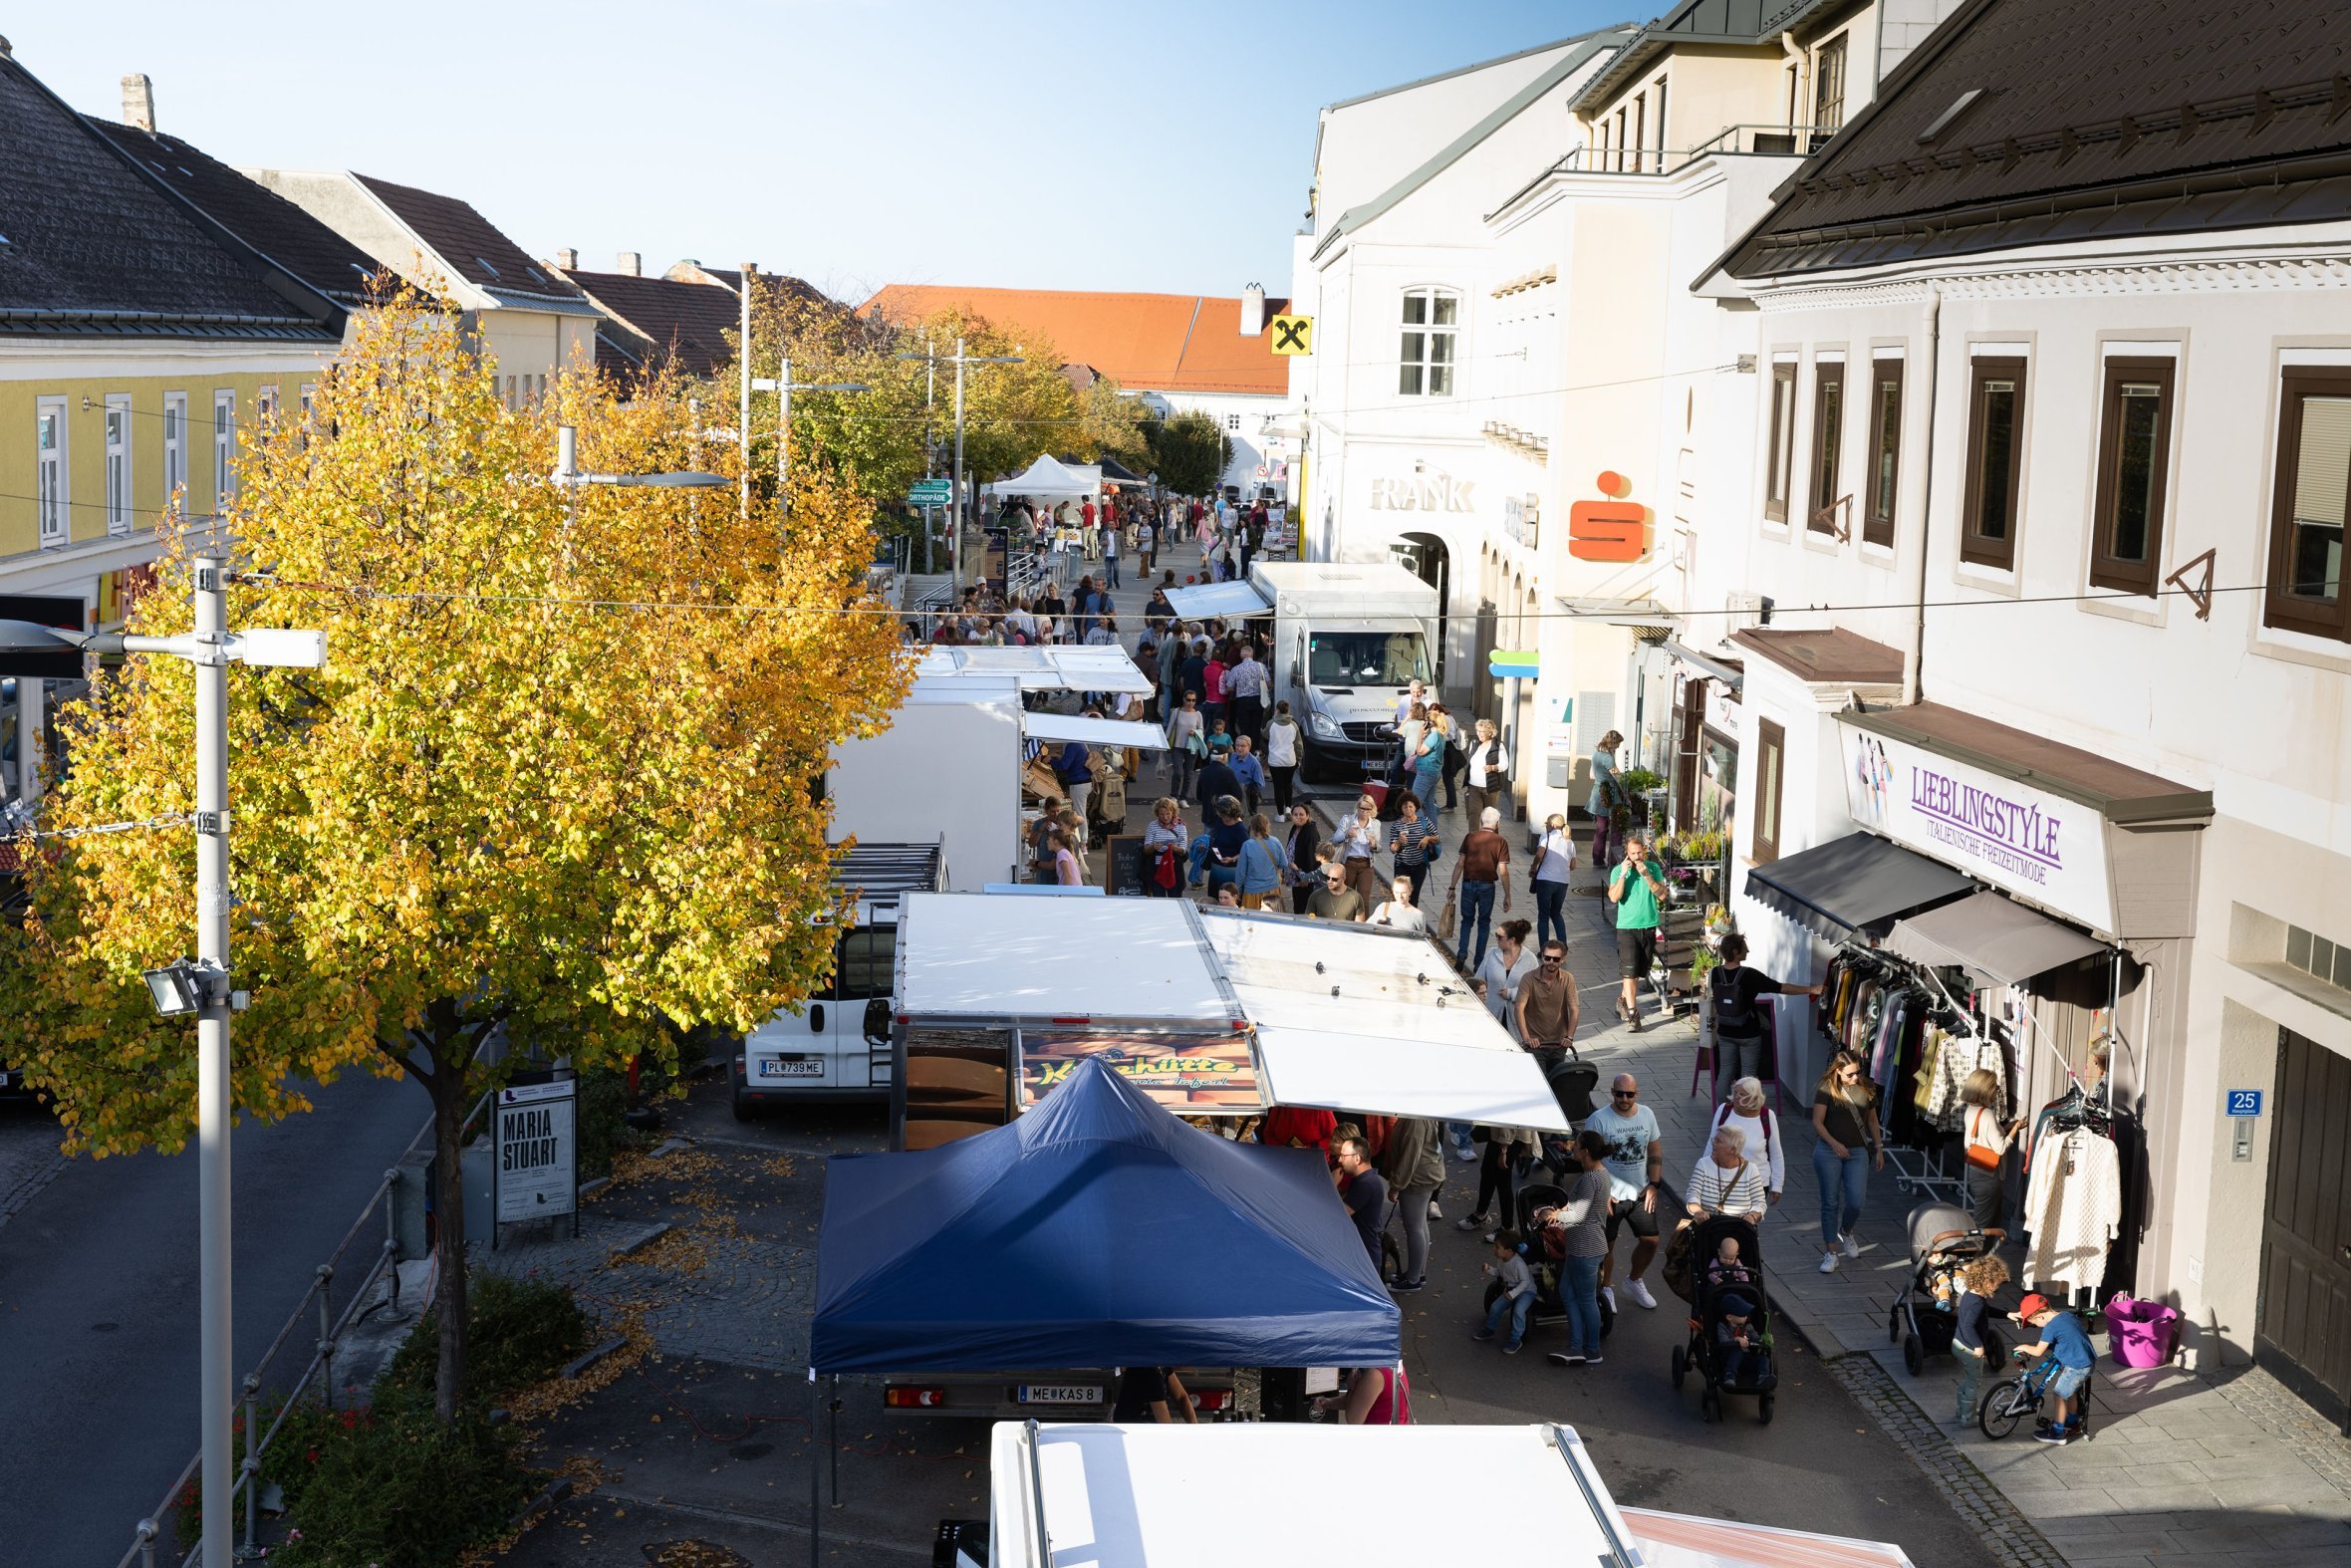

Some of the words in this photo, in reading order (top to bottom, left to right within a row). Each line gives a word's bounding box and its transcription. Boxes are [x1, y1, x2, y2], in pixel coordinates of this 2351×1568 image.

[1369, 476, 1474, 513] FRANK
[1912, 766, 2062, 862] LIEBLINGSTYLE
[1927, 820, 1980, 857] ITALIENISCHE
[1982, 843, 2046, 885] FREIZEITMODE
[769, 1063, 779, 1073] PL
[787, 1063, 805, 1073] 739
[806, 1063, 819, 1073] ME
[1036, 1056, 1239, 1086] Kehütte
[2234, 1093, 2255, 1109] 25
[503, 1108, 552, 1143] MARIA
[503, 1138, 558, 1171] STUART
[1032, 1388, 1049, 1401] ME
[1059, 1388, 1083, 1401] KAS
[1086, 1388, 1094, 1401] 8
